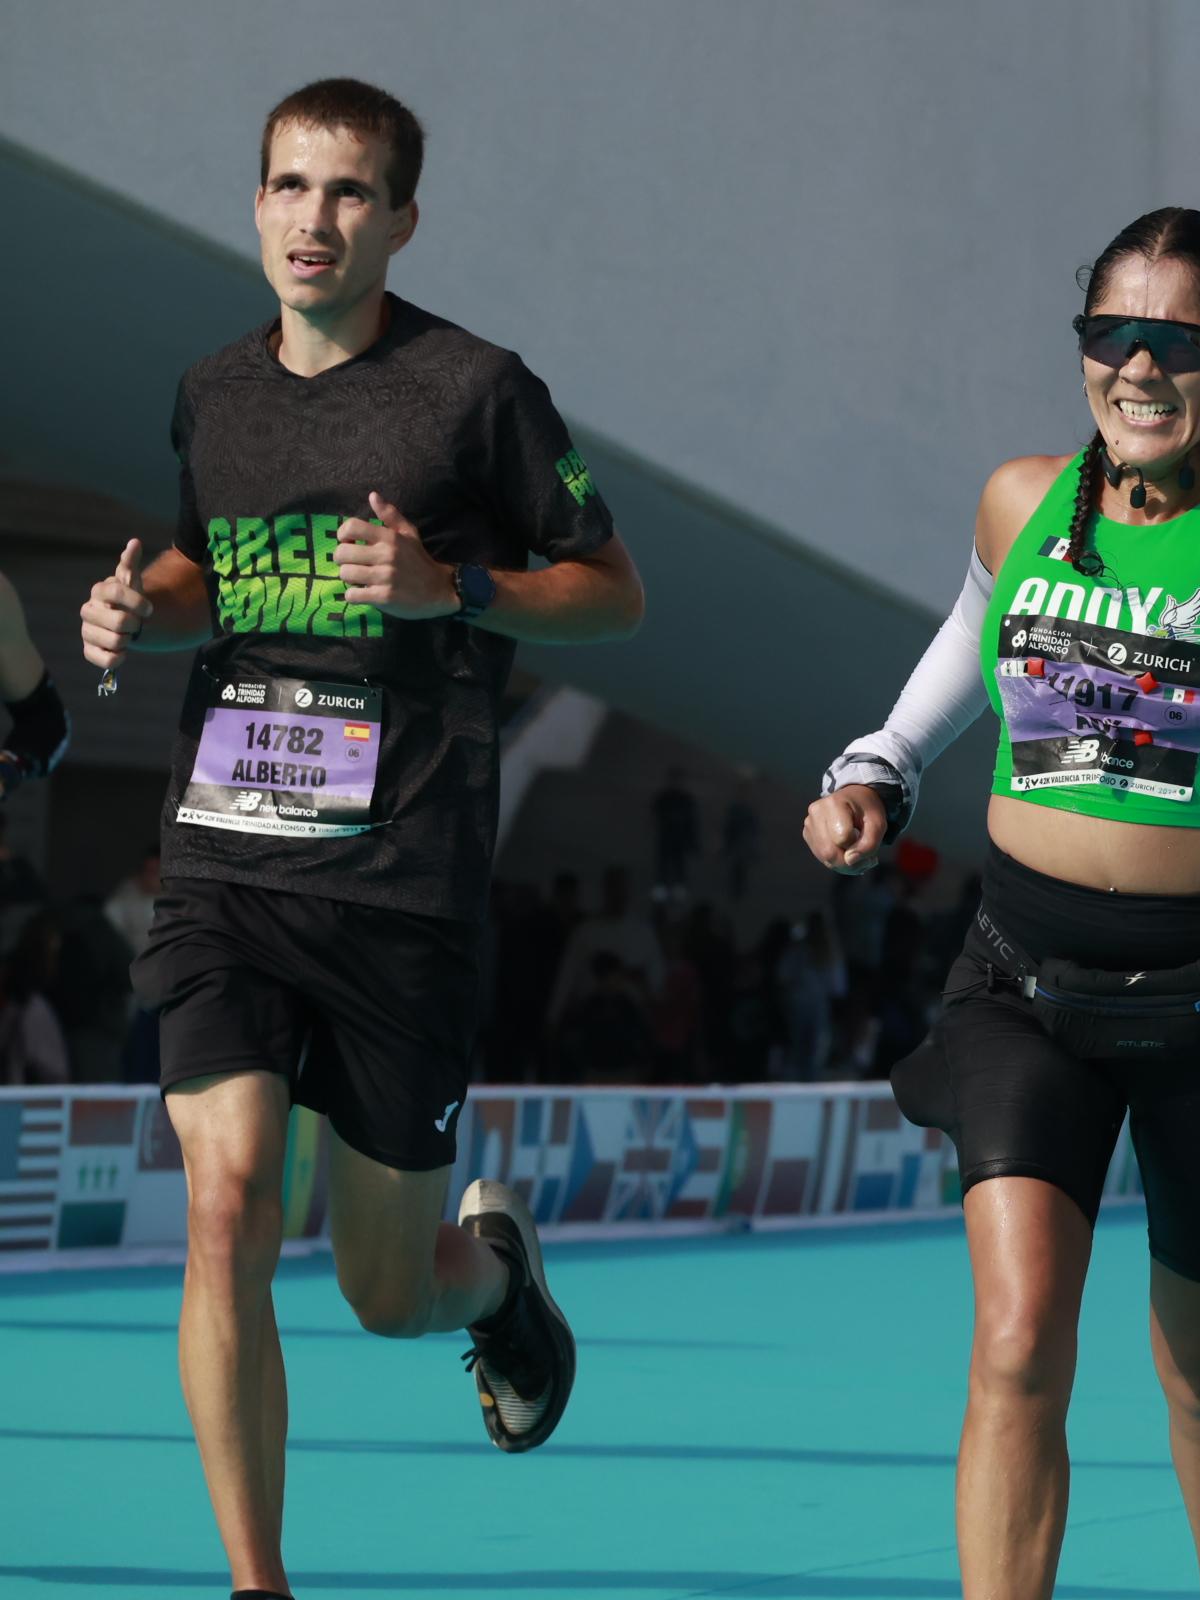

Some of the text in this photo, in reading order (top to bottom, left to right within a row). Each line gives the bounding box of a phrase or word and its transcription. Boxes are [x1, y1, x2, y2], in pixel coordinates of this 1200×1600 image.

[207, 513, 384, 577] GREE
[1028, 633, 1071, 647] TRINIDAD
[1028, 641, 1069, 655] ALFONSO
[1132, 651, 1191, 673] ZURICH
[236, 695, 265, 704] ALFONSO
[237, 688, 266, 697] TRINIDAD
[317, 694, 365, 710] ZURICH
[1169, 711, 1183, 721] 06
[245, 721, 324, 756] 14782
[348, 748, 360, 758] 06
[231, 759, 327, 788] ALBERTO
[1050, 774, 1080, 784] VALENCIA
[259, 804, 318, 817] new balance
[272, 822, 306, 832] ALFONSO
[978, 902, 1015, 960] LETIC
